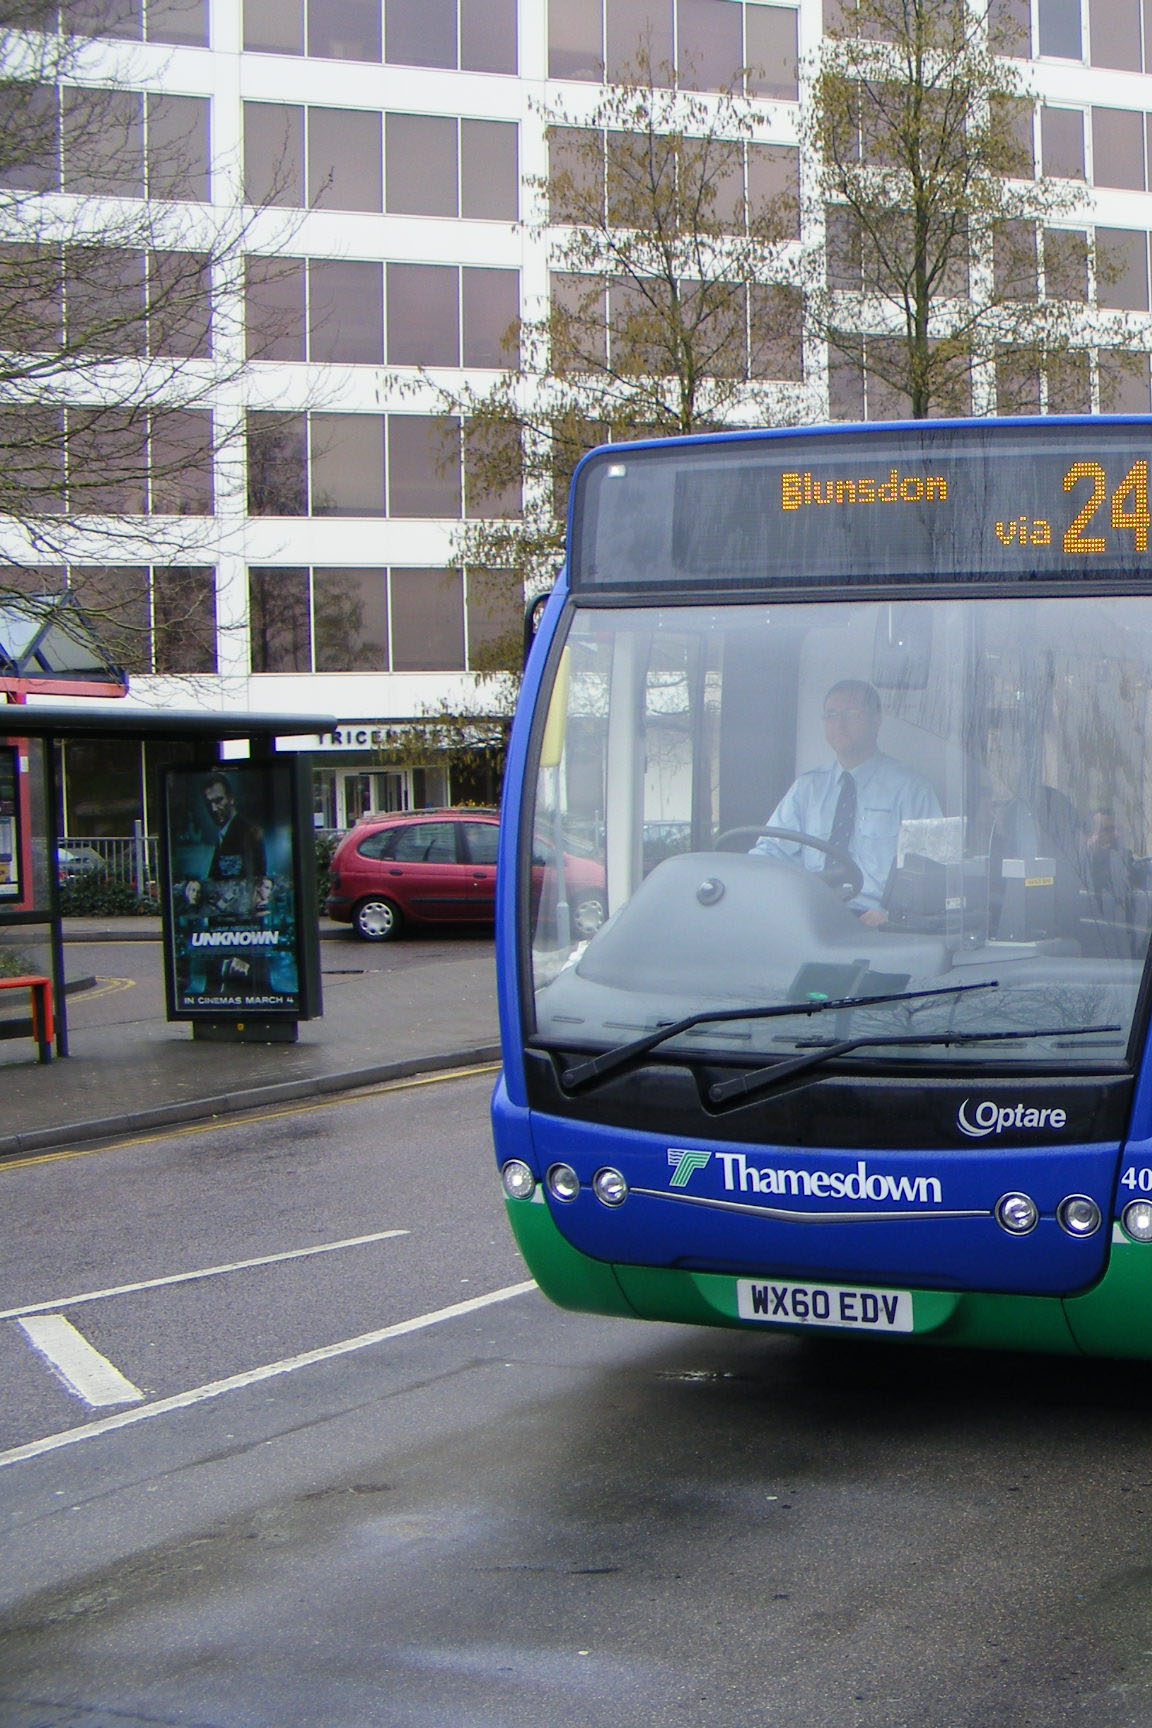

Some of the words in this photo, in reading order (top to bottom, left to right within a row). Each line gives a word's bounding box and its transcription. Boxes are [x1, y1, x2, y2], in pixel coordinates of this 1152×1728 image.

[781, 469, 948, 511] Blunsdon
[995, 516, 1052, 546] via
[1061, 459, 1151, 554] 24
[191, 930, 280, 947] UNKNOWN
[184, 996, 195, 1005] IN
[197, 996, 242, 1005] CINEMAS
[245, 996, 283, 1005] MARCH
[286, 996, 294, 1004] 4
[974, 1101, 1067, 1133] Optare
[715, 1151, 942, 1203] Thamesdown
[750, 1284, 831, 1320] WX60
[839, 1290, 899, 1325] EDV
